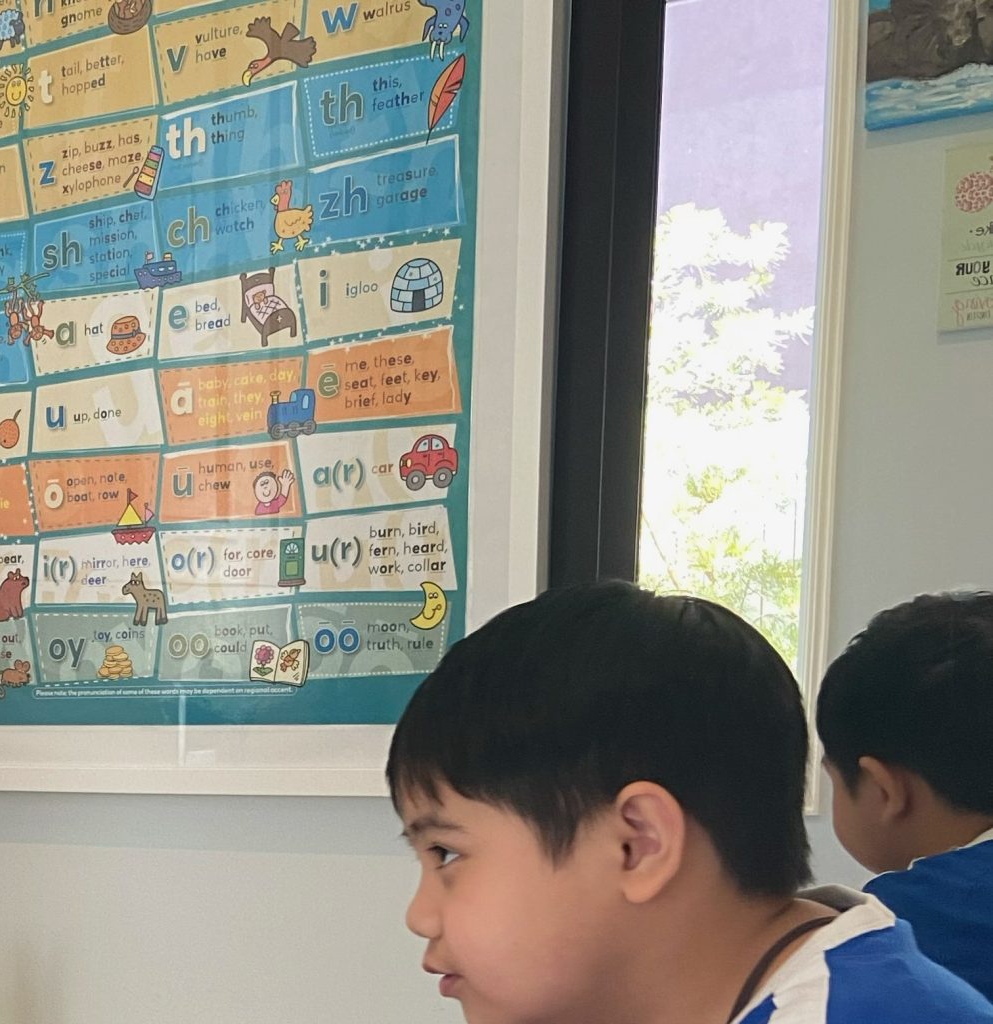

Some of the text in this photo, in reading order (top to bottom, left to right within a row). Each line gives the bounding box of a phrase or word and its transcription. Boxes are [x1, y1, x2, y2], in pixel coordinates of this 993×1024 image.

[61, 7, 103, 28] gnome
[363, 0, 411, 21] walrus
[195, 25, 243, 44] vulture,
[196, 47, 226, 63] have
[61, 55, 124, 77] tail, better,
[38, 70, 52, 104] t
[62, 74, 105, 95] hopped
[373, 77, 402, 92] this,
[319, 81, 363, 125] th
[373, 91, 425, 111] feather
[211, 105, 257, 125] thumb,
[166, 117, 206, 159] th
[211, 129, 244, 144] thing
[62, 133, 143, 159] zip, buzz, has,
[62, 152, 144, 176] cheese, maze,
[62, 174, 121, 195] xylophone
[319, 175, 368, 220] zh
[377, 187, 427, 208] garage
[167, 205, 209, 247] ch
[216, 217, 254, 235] watch
[89, 230, 137, 246] mission,
[43, 231, 81, 269] sh
[90, 249, 133, 264] station,
[90, 265, 130, 282] special
[346, 281, 378, 299] igloo
[196, 297, 220, 313] bed,
[84, 323, 103, 335] hat
[196, 314, 230, 331] bread
[345, 354, 415, 372] me, these,
[234, 373, 266, 386] cake,
[269, 369, 296, 383] day,
[345, 368, 440, 390] seat, feet, key,
[345, 389, 411, 408] brief, lady
[73, 407, 121, 424] up, done
[237, 411, 262, 422] vein
[199, 458, 274, 474] human, use,
[313, 458, 364, 490] a(r)
[372, 463, 393, 474] car
[98, 490, 119, 499] row
[199, 480, 230, 491] chew
[369, 521, 439, 538] burn, bird,
[223, 548, 276, 560] for, core,
[311, 536, 362, 568] u(r)
[369, 540, 448, 557] fern, heard,
[171, 546, 215, 576] o(r)
[368, 559, 446, 574] work, collar
[81, 575, 106, 585] deer
[223, 566, 251, 577] door
[116, 628, 145, 639] coins
[214, 641, 247, 653] could
[408, 637, 433, 649] rule
[49, 638, 85, 668] oy
